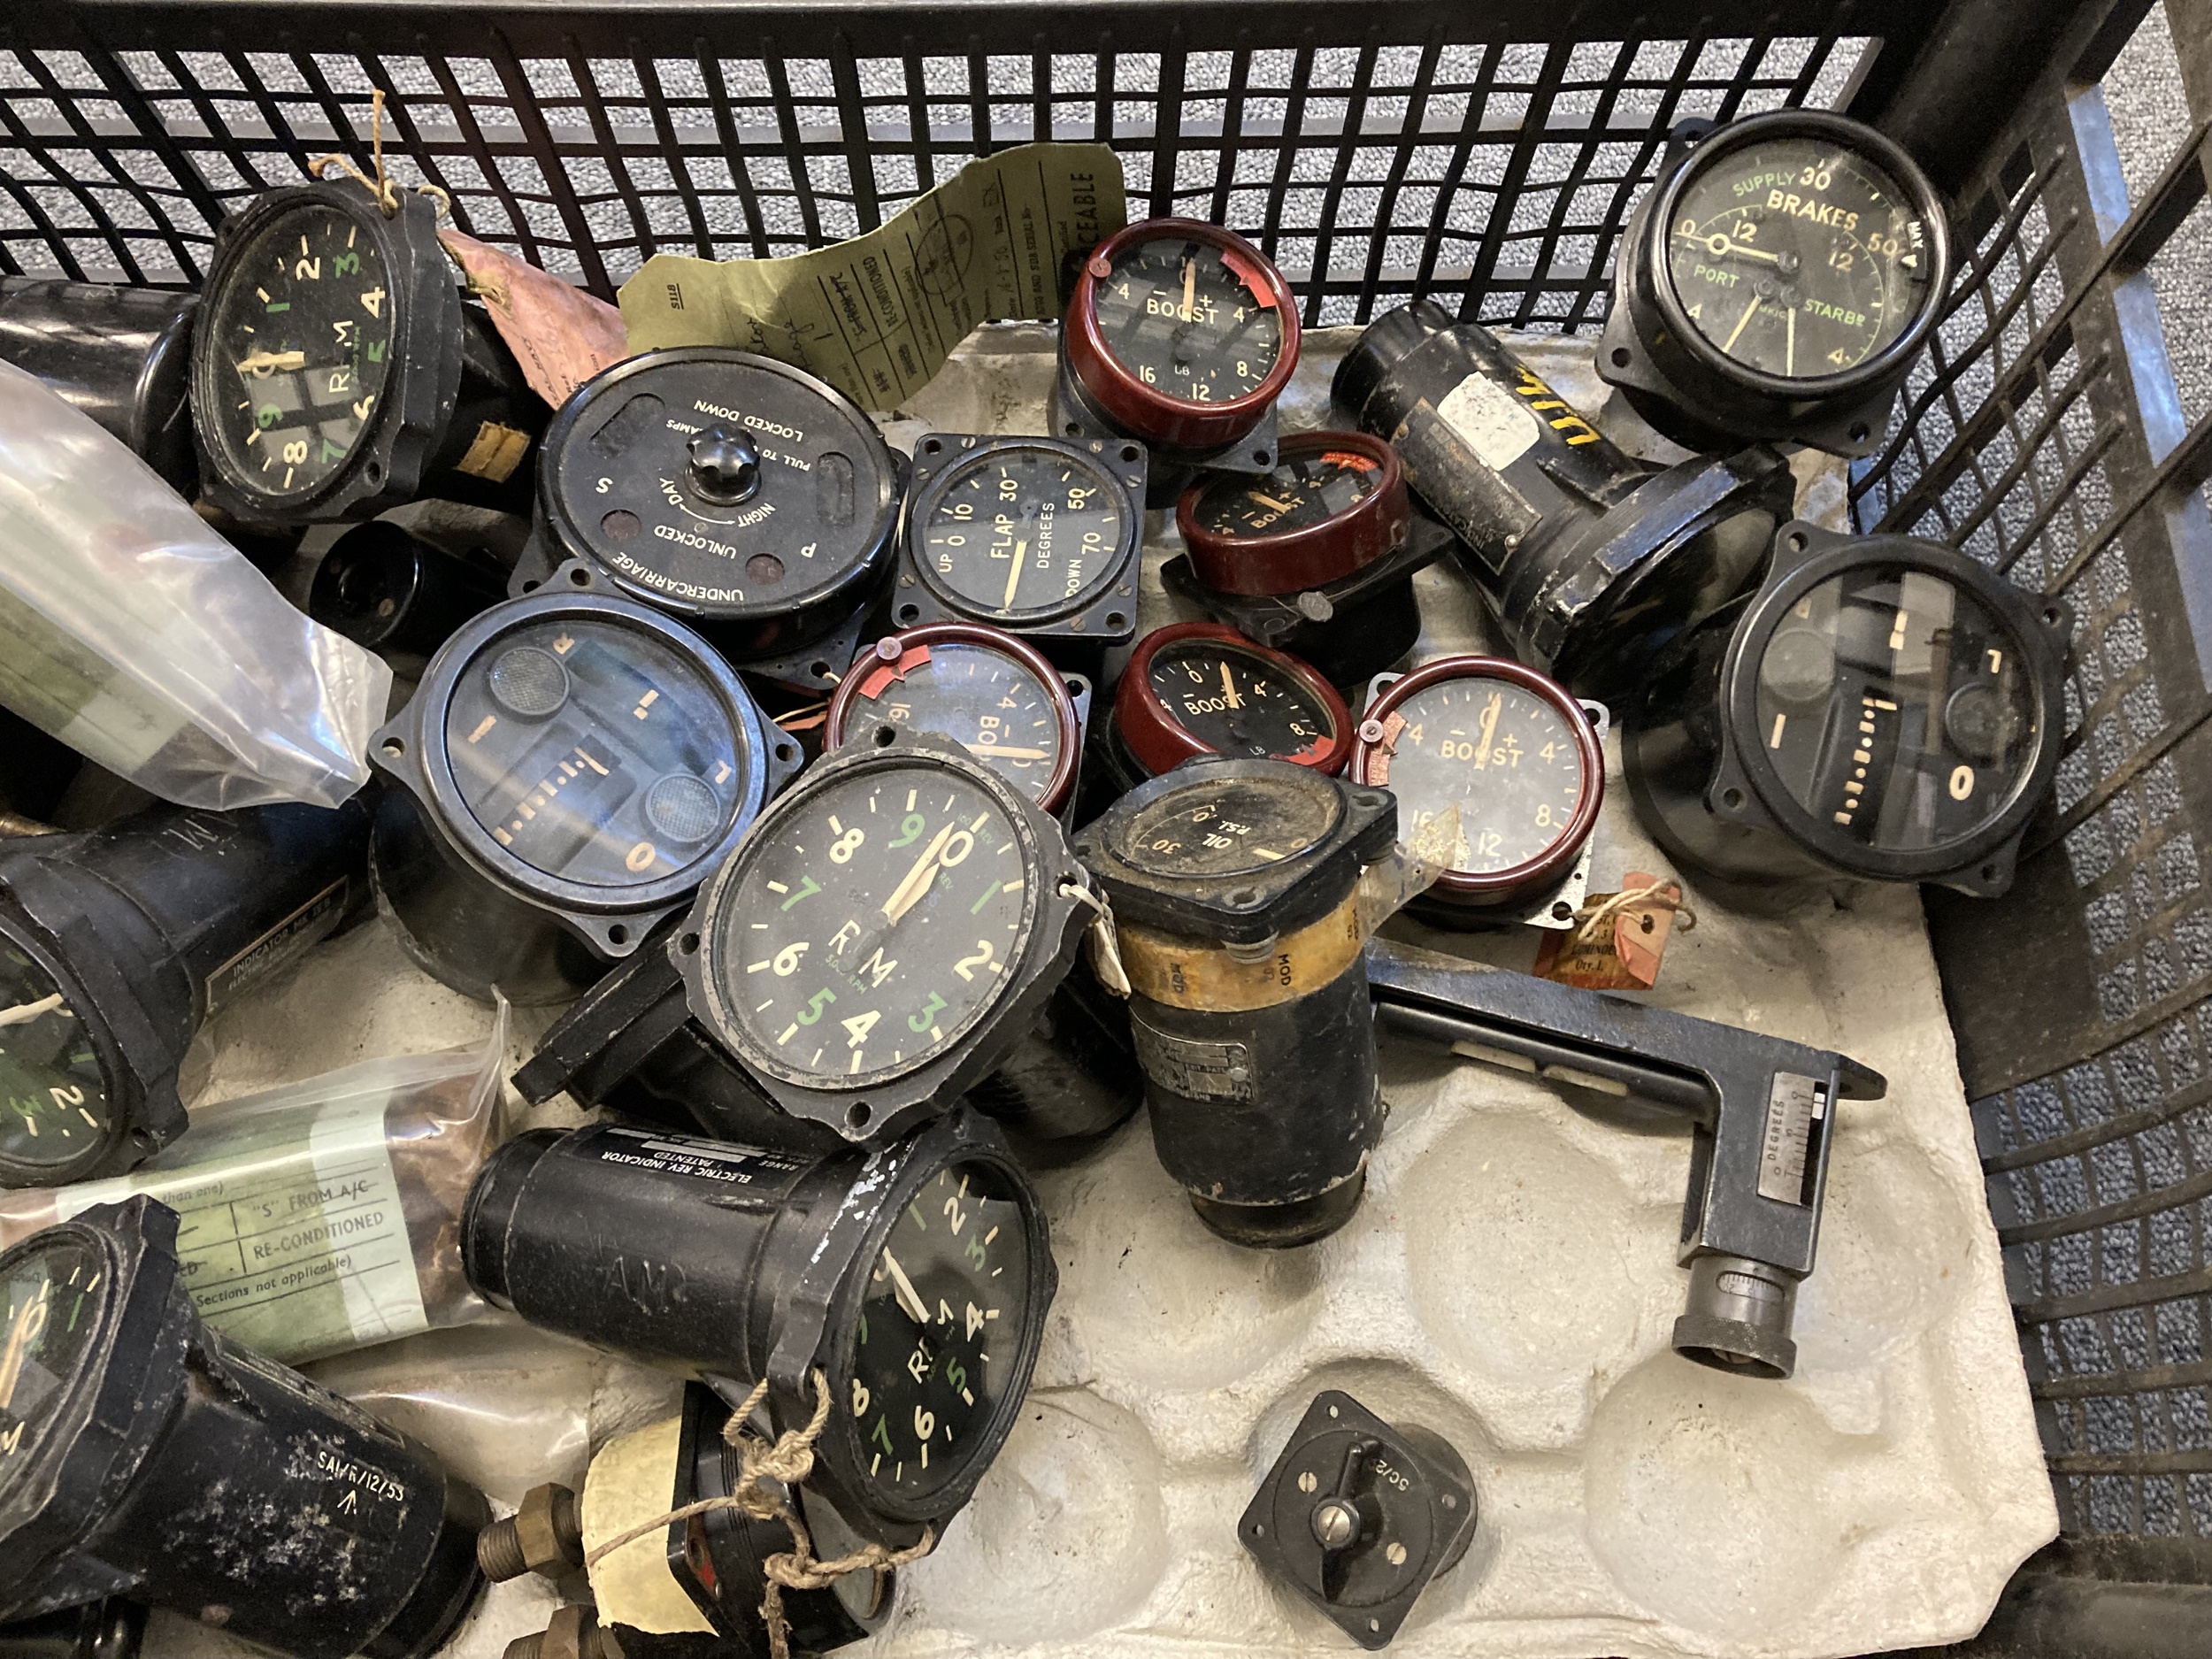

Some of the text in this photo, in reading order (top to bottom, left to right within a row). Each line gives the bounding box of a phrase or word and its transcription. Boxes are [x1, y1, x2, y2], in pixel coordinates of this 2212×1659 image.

[1732, 172, 1796, 197] SUPPLY
[1800, 166, 1832, 191] 30
[1071, 173, 1099, 242] CEABLE
[1766, 188, 1859, 232] BRAKES
[1732, 219, 1757, 242] 12
[1906, 220, 1924, 250] MAX
[1868, 233, 1899, 256] 50
[296, 257, 320, 280] 2
[335, 252, 360, 279] 3
[1828, 251, 1855, 273] 12
[1694, 264, 1740, 288] PORT
[361, 287, 386, 319] 4
[1118, 283, 1130, 300] 4
[1233, 307, 1245, 323] 4
[1139, 365, 1156, 384] 16
[1174, 364, 1190, 376] LB
[1236, 361, 1248, 377] 8
[1192, 382, 1211, 402] 12
[257, 403, 283, 428] 9
[694, 399, 803, 442] LOCKED DOWN
[283, 440, 307, 465] 8
[321, 440, 347, 464] 7
[762, 448, 778, 461] TO
[783, 454, 811, 472] PULL
[595, 477, 613, 494] S
[658, 476, 685, 507] DAY
[999, 479, 1018, 502] 30
[954, 503, 974, 520] 10
[1067, 488, 1086, 510] 50
[736, 502, 776, 528] NIGHT
[653, 524, 737, 559] UNLOCKED
[947, 534, 966, 547] 0
[990, 513, 1016, 558] FLAP
[1036, 502, 1055, 569] DEGREES
[1081, 532, 1101, 556] 70
[800, 541, 818, 558] P
[938, 553, 954, 572] UP
[611, 550, 744, 602] UNDERCARRIAGE
[1064, 559, 1082, 598] DOWN
[1187, 669, 1203, 684] 0
[997, 696, 1017, 709] 4
[1255, 683, 1267, 697] 4
[888, 701, 911, 721] 16
[1289, 722, 1306, 736] 8
[1408, 725, 1424, 746] 4
[1249, 745, 1266, 757] LB
[1539, 741, 1555, 765] 4
[1535, 804, 1551, 828] 8
[889, 813, 926, 849] 9
[1202, 833, 1233, 849] OIL
[1290, 837, 1308, 849] 0
[828, 827, 865, 864] 8
[938, 830, 975, 868] 0
[1152, 839, 1181, 855] 30
[1479, 833, 1503, 858] 12
[780, 875, 822, 912] 7
[969, 879, 1003, 916] 1
[232, 929, 290, 977] INDICATOR
[772, 941, 810, 978] 6
[953, 940, 995, 982] 2
[1278, 953, 1292, 987] MOD
[797, 987, 837, 1026] 5
[907, 990, 949, 1033] 3
[841, 1010, 881, 1049] 4
[49, 1085, 84, 1110] 2
[1768, 1100, 1785, 1161] DEGREES
[601, 1150, 752, 1184] ELECTRIC REV. INDICATOR
[653, 1149, 714, 1168] PATENTED
[758, 1158, 798, 1172] RANGE
[288, 1188, 333, 1211] FROM
[943, 1196, 966, 1236] 2
[253, 1211, 384, 1260] RE-CONDITIONED
[964, 1234, 987, 1271] 3
[196, 1254, 352, 1309] Sections not applicable)
[966, 1302, 984, 1342] 4
[946, 1356, 967, 1394] 5
[872, 1413, 894, 1455] 7
[915, 1405, 934, 1440] 6
